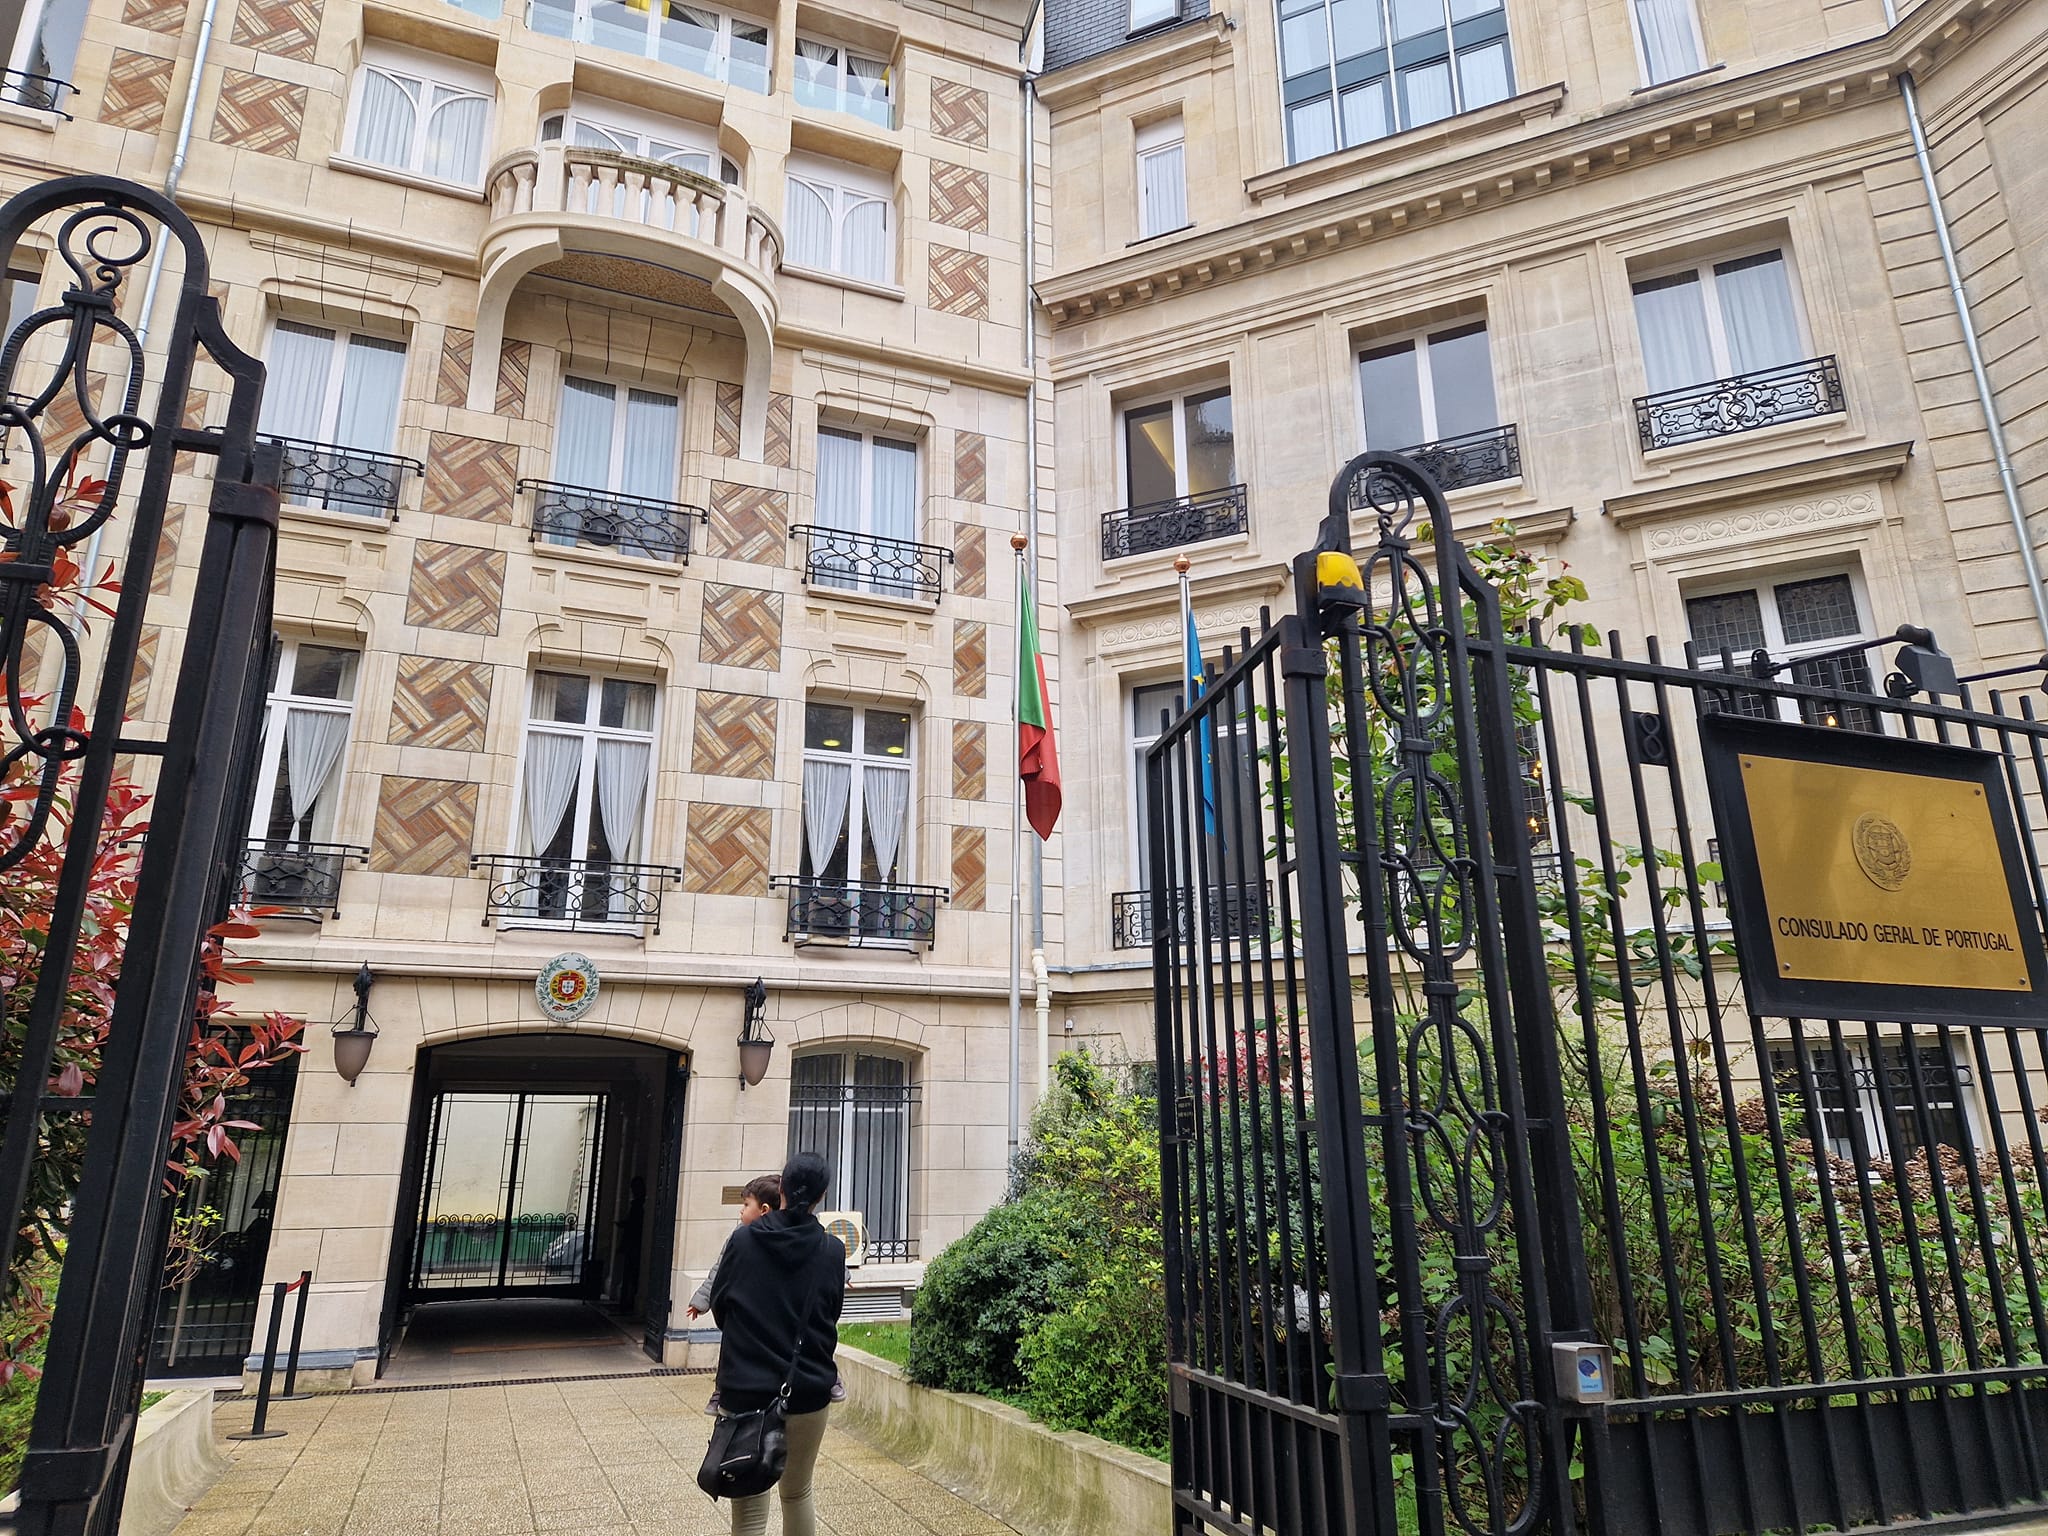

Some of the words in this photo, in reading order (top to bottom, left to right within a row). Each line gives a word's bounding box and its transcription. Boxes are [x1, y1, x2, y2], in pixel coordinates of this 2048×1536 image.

[1640, 714, 1664, 758] 8
[1778, 916, 1868, 942] CONSULADO
[1873, 924, 1919, 945] GERAL
[1923, 927, 1942, 946] DE
[1946, 930, 2014, 951] PORTUGAL
